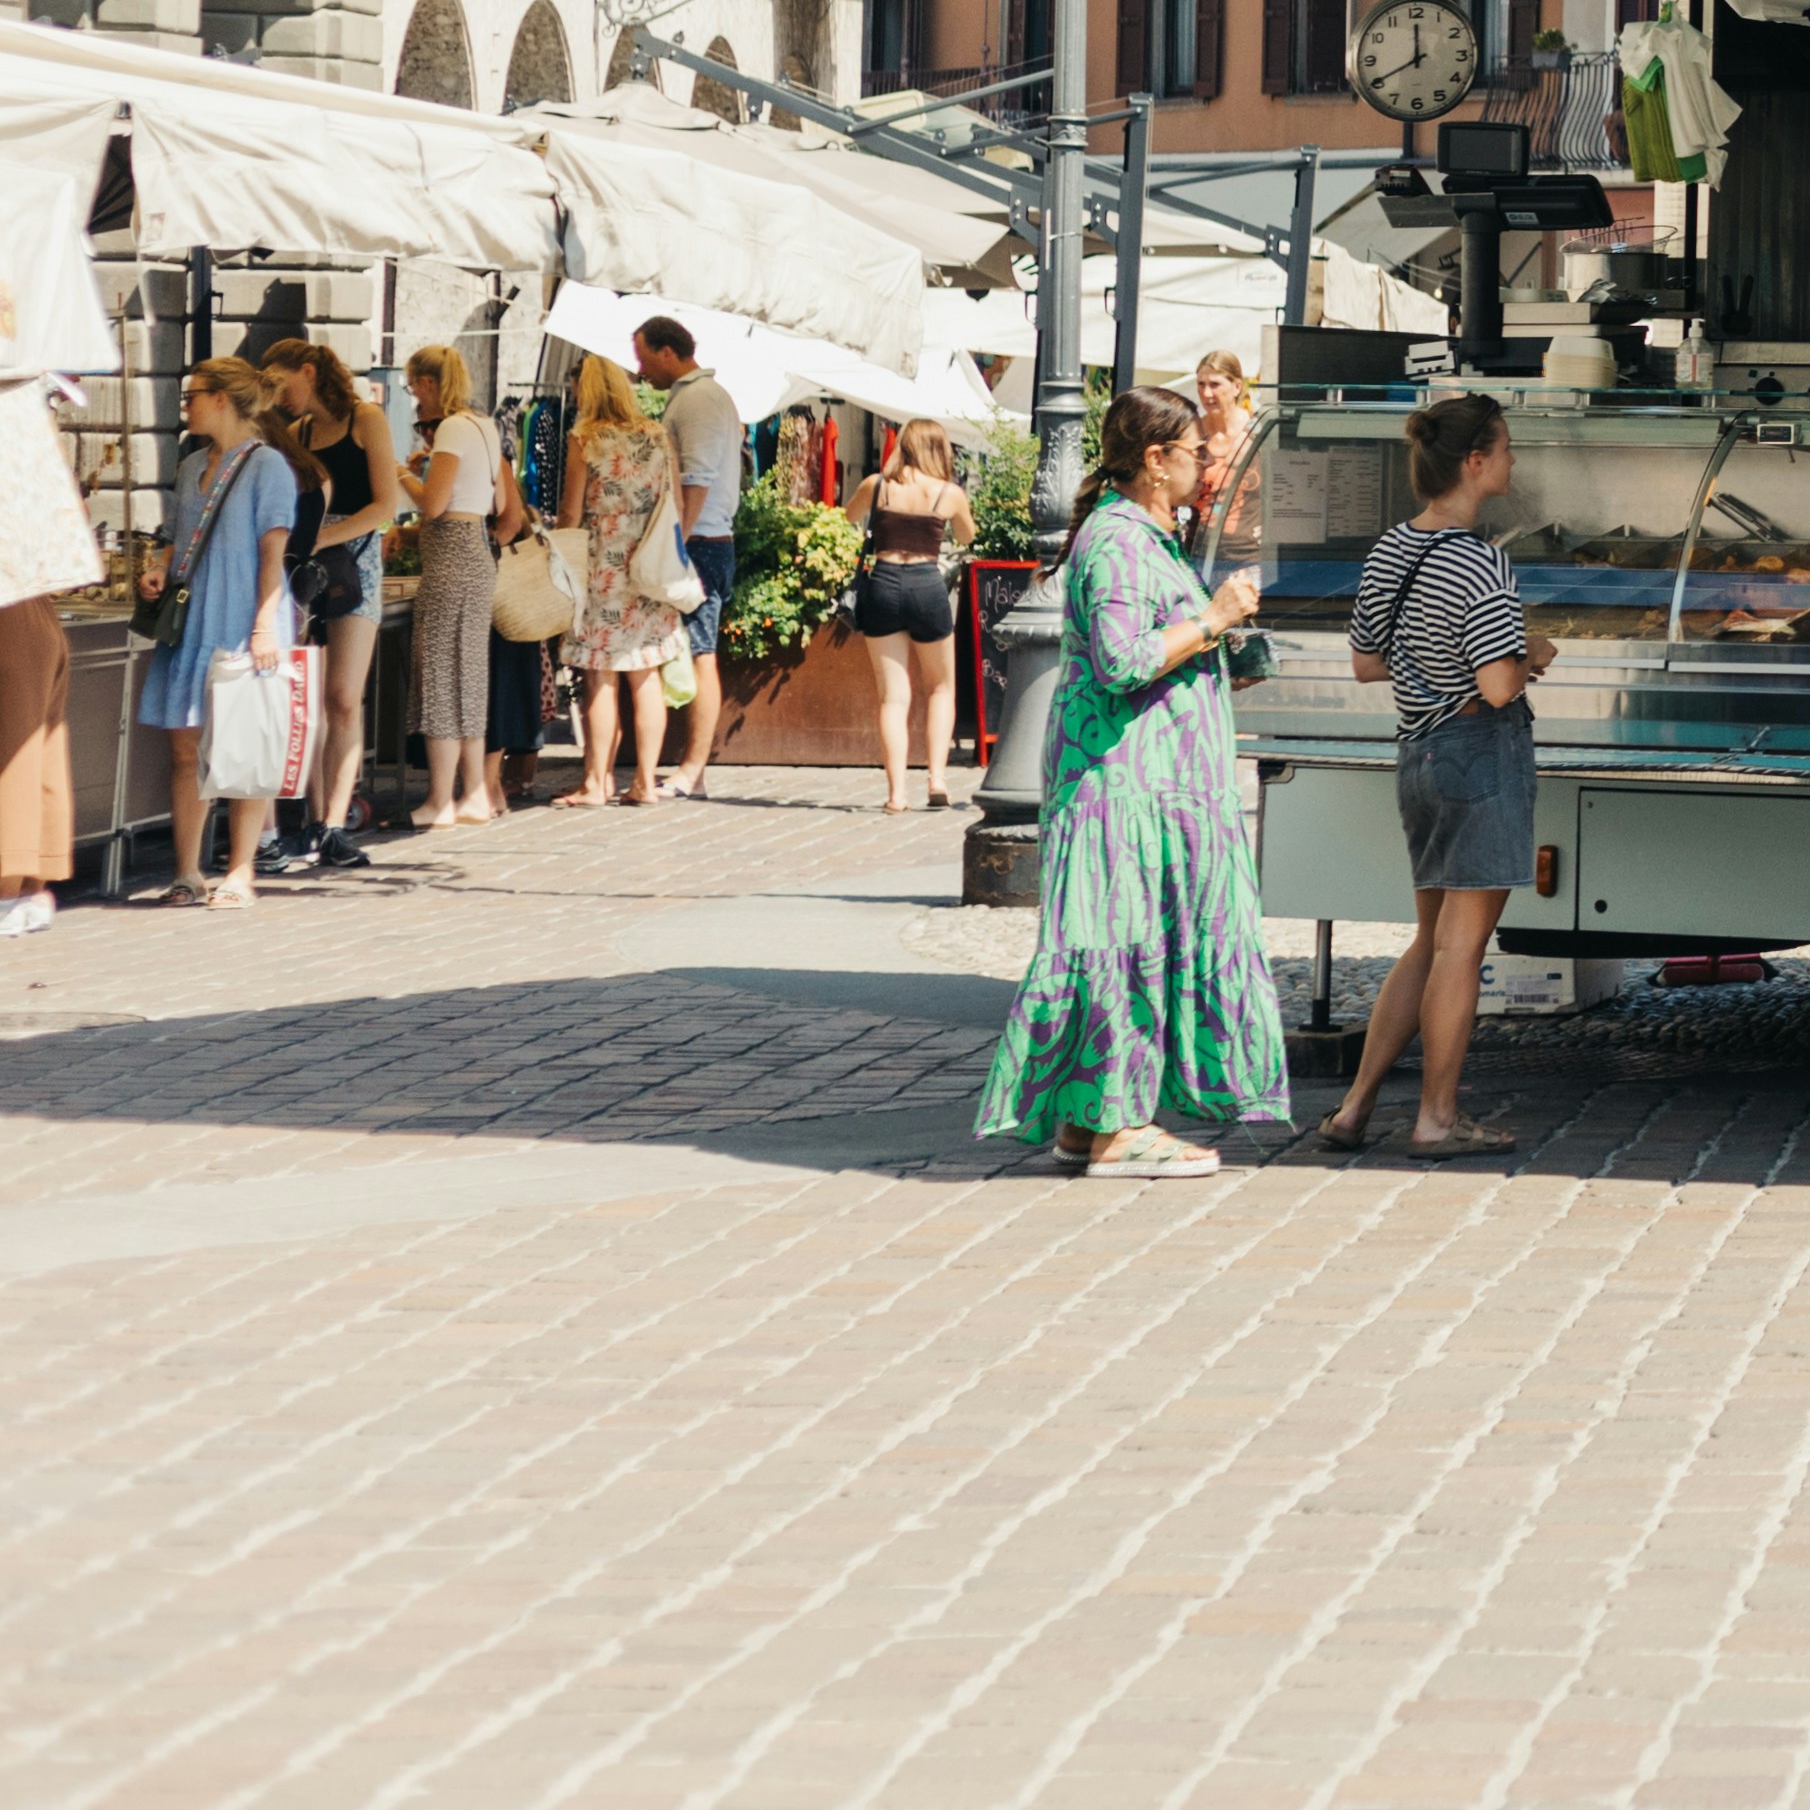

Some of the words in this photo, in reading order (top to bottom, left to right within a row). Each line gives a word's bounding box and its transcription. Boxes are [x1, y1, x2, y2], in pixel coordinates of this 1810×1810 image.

[1408, 7, 1424, 19] 12
[1436, 12, 1441, 23] 1
[1388, 16, 1397, 28] 11
[1372, 32, 1384, 44] 10
[1448, 27, 1460, 39] 2
[1364, 55, 1377, 67] 9
[1455, 50, 1468, 62] 3
[1449, 71, 1461, 83] 4
[1389, 93, 1400, 106] 7
[1433, 89, 1446, 102] 5
[1411, 97, 1424, 110] 6
[283, 765, 299, 792] LES
